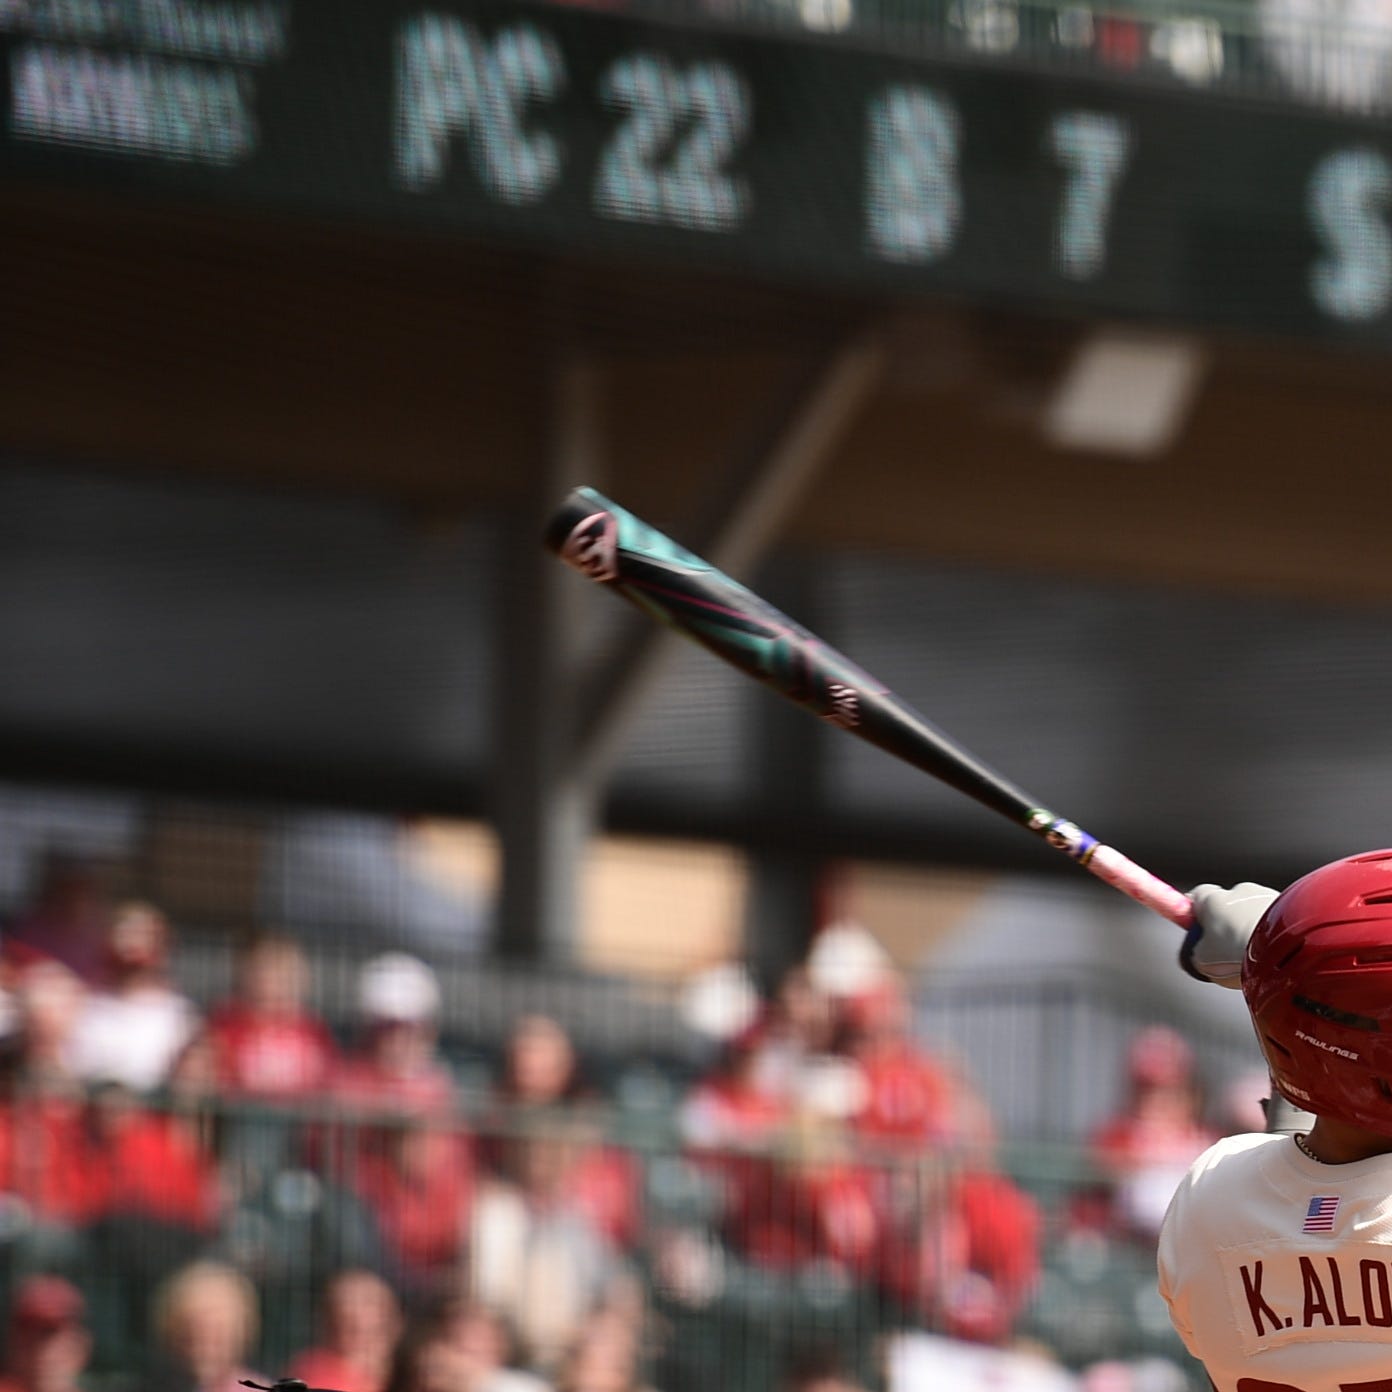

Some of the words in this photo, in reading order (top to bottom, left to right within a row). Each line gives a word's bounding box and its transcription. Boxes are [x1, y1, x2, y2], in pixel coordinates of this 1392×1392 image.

[393, 14, 565, 203] PC
[594, 52, 752, 232] 22
[1048, 110, 1130, 281] 7
[1295, 1030, 1360, 1061] RAWLINGS
